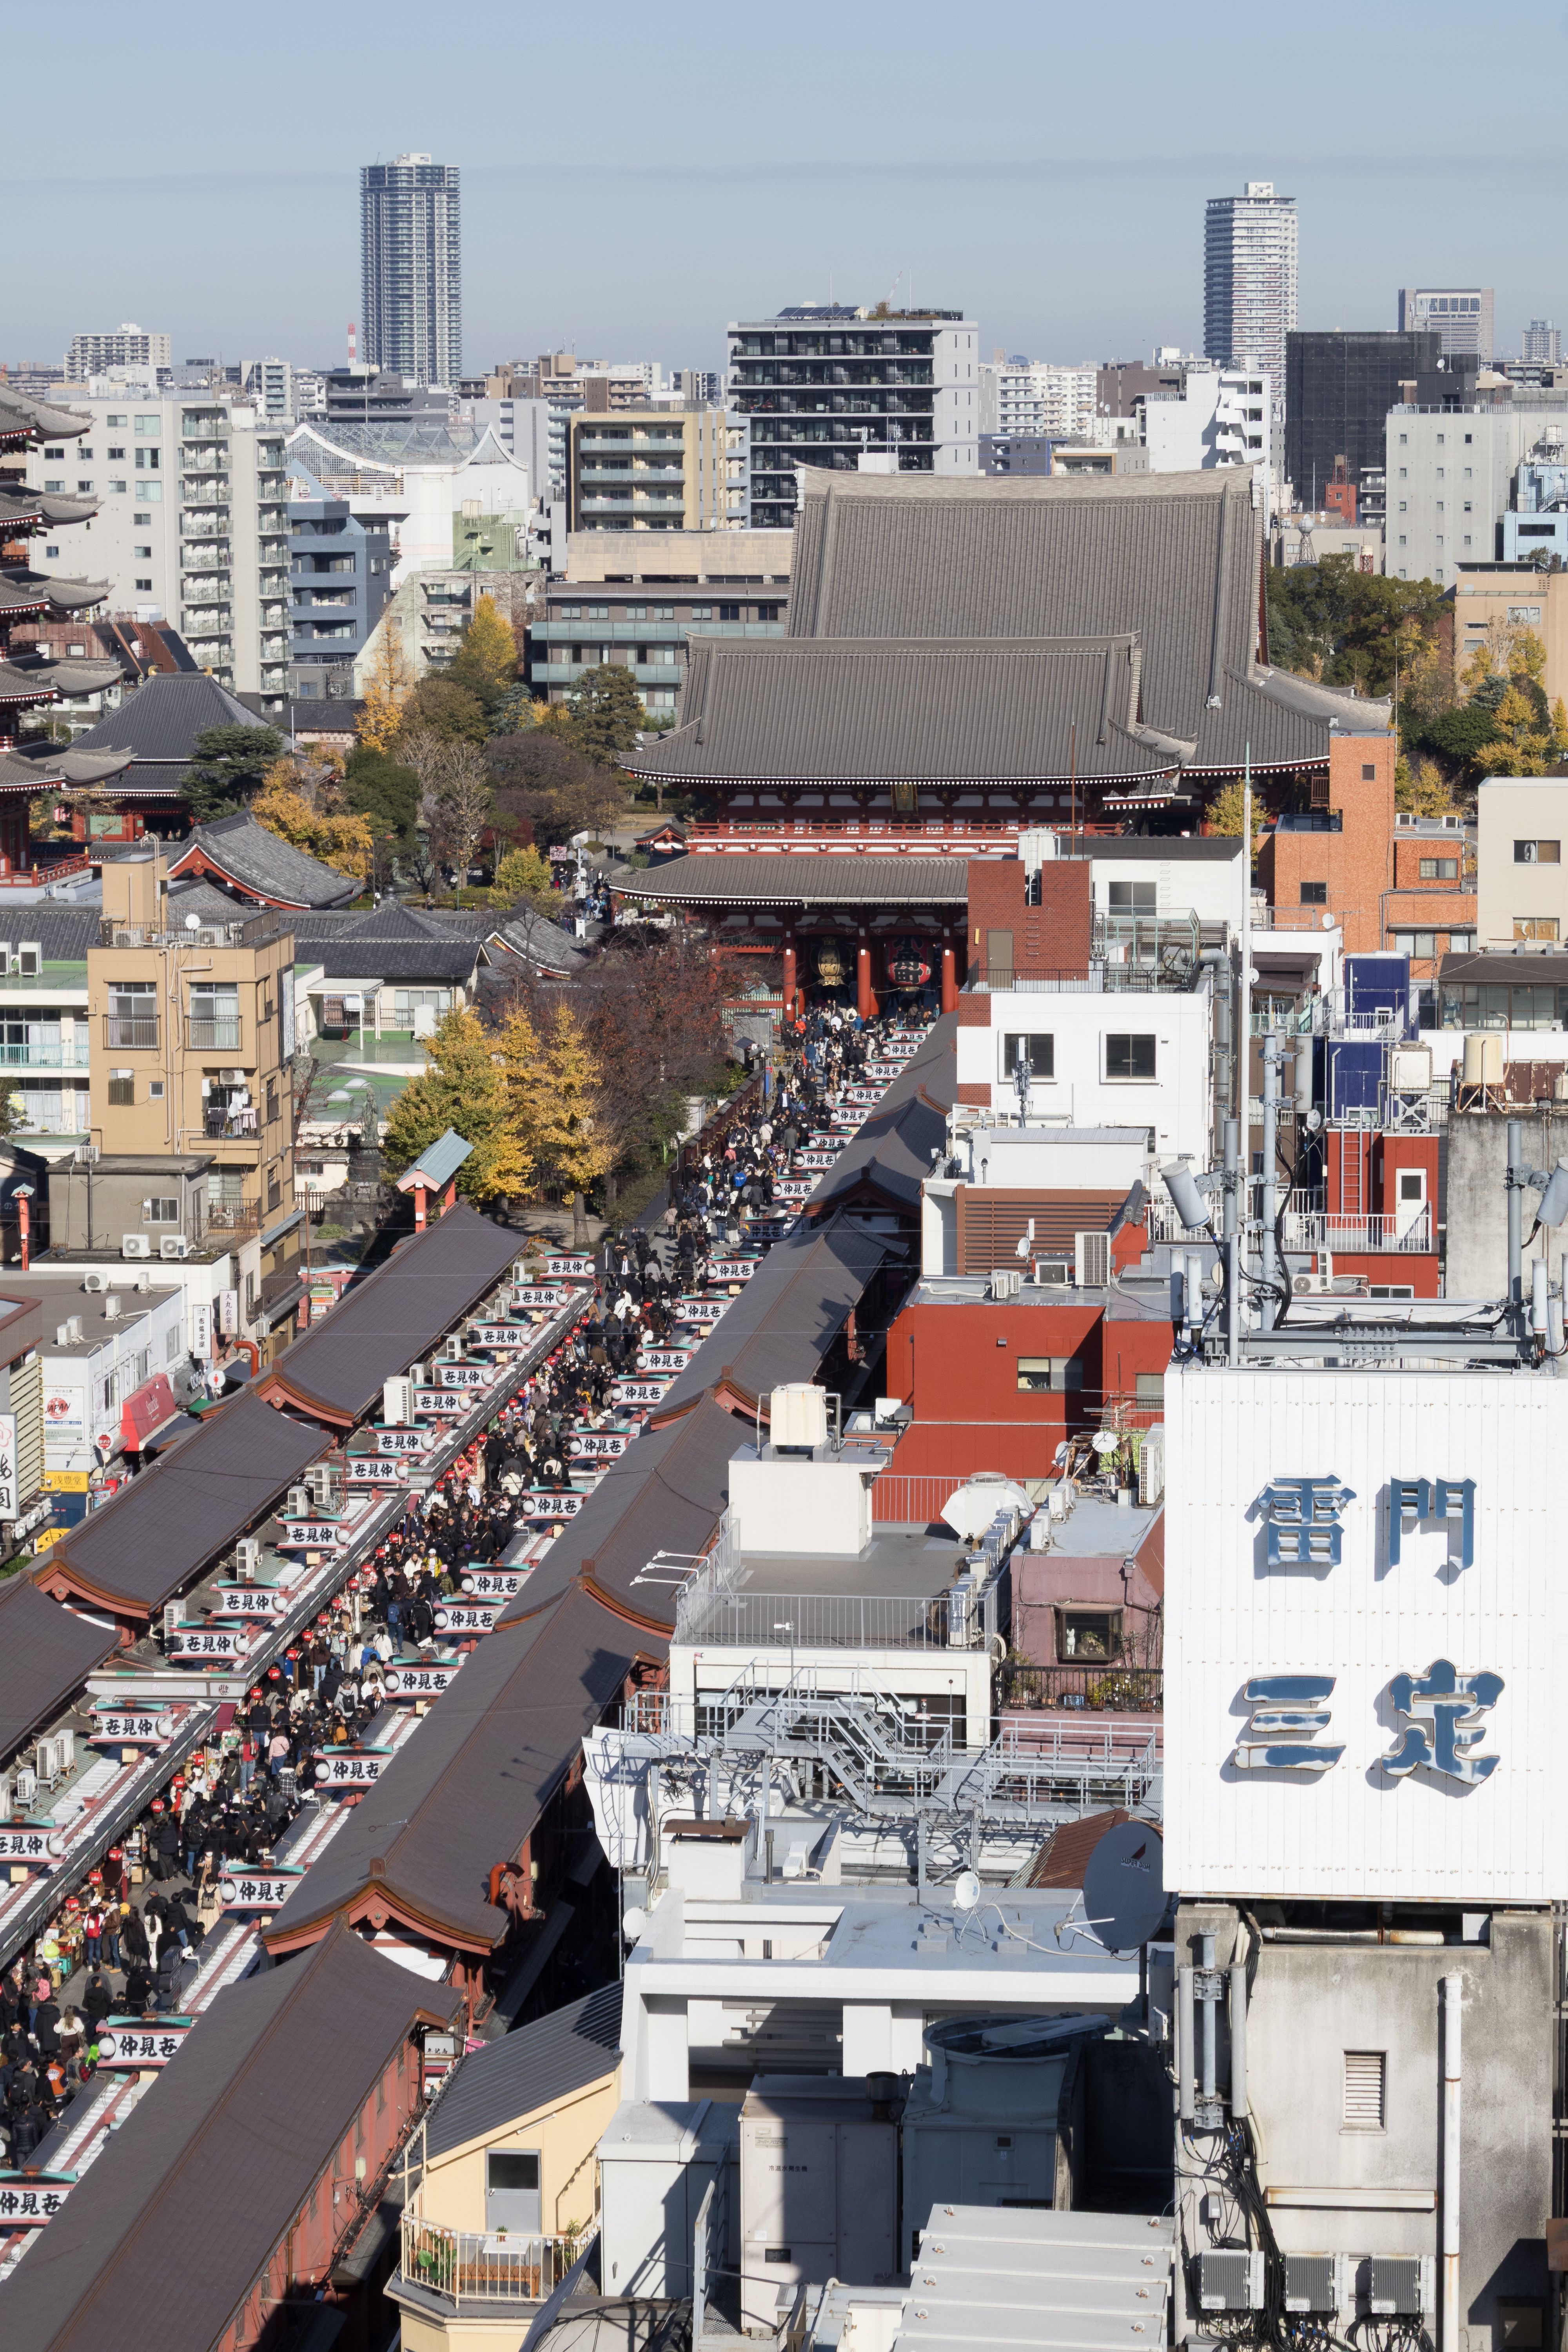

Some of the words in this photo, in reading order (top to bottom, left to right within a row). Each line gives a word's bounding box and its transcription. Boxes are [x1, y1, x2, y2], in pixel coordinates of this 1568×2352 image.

[892, 1045, 915, 1054] 仲見世
[875, 1067, 898, 1076] 仲見世
[857, 1090, 881, 1100] 仲見世
[806, 1154, 834, 1165] 仲見世
[784, 1183, 811, 1195] 仲見世
[751, 1225, 782, 1238] 仲見世
[720, 1265, 750, 1276] 仲見世
[688, 1305, 721, 1318] 仲見世
[650, 1354, 684, 1367] 仲見世
[625, 1387, 660, 1399] 仲見世
[45, 1403, 71, 1414] JAPAN
[584, 1439, 621, 1454] 仲見世
[54, 1475, 82, 1485] 浅豊堂
[538, 1499, 577, 1514] 仲見世
[1257, 1471, 1478, 1570] 雷門
[477, 1576, 517, 1591] 仲見世
[451, 1611, 492, 1627] 仲見世
[403, 1673, 447, 1689] 仲見世
[1234, 1658, 1506, 1786] 三定
[334, 1762, 378, 1779] 仲見世
[1121, 1857, 1137, 1867] SUPER
[120, 2036, 178, 2056] 仲見世
[0, 2191, 62, 2216] 仲見世
